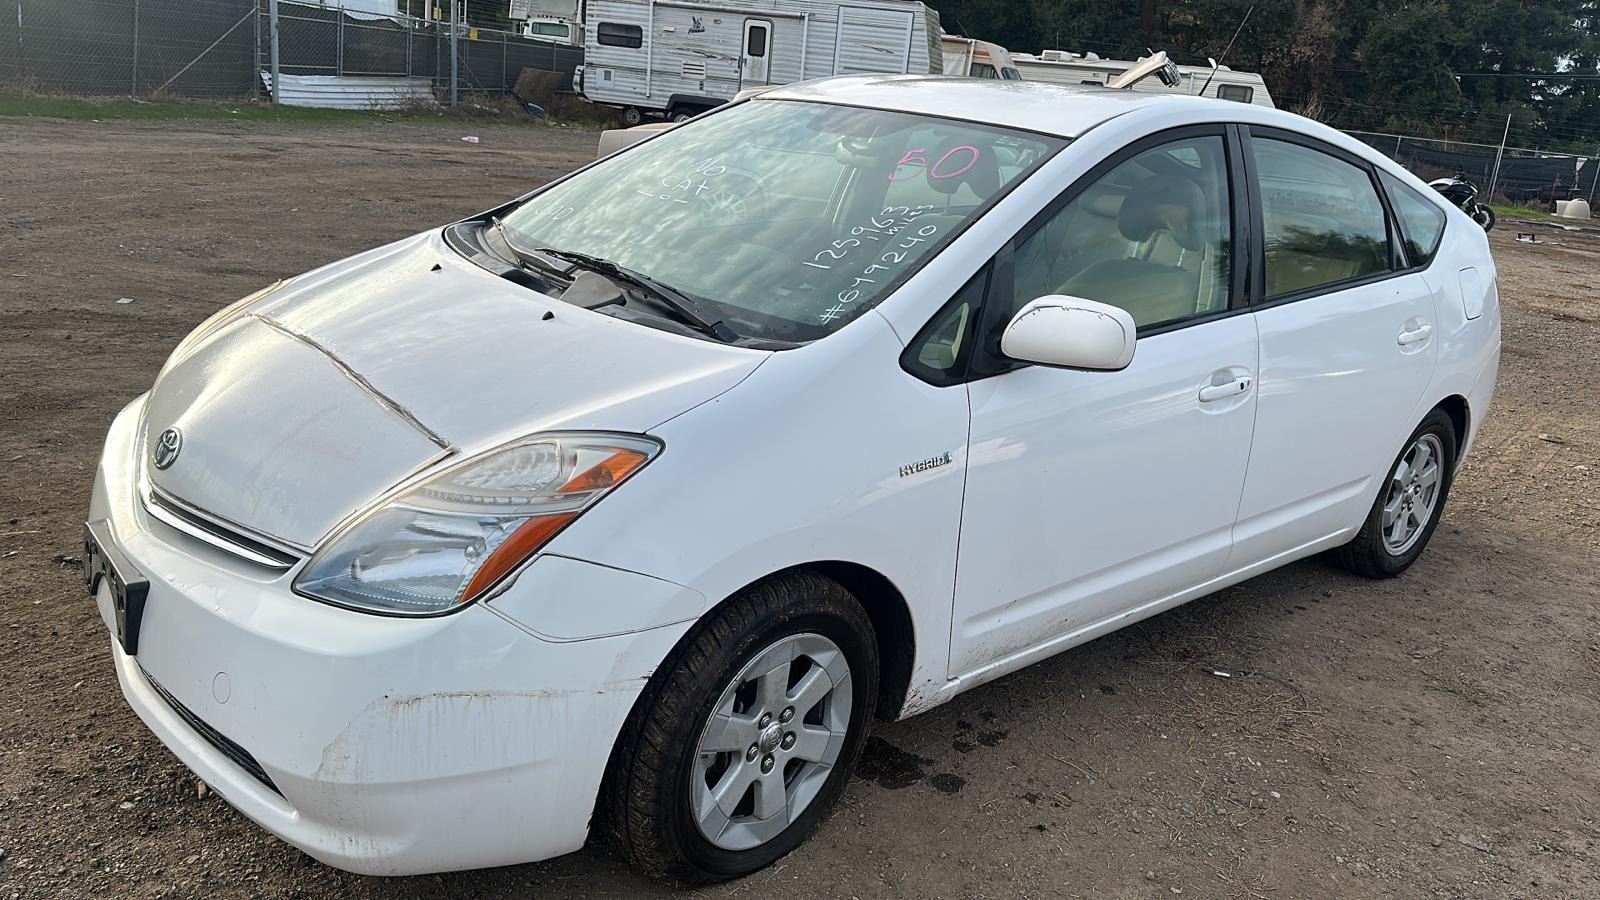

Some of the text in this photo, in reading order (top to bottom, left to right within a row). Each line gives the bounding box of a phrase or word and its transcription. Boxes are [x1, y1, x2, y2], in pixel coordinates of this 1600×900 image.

[889, 146, 980, 181] 50
[820, 225, 936, 326] #649240
[899, 456, 945, 478] HYBRID
